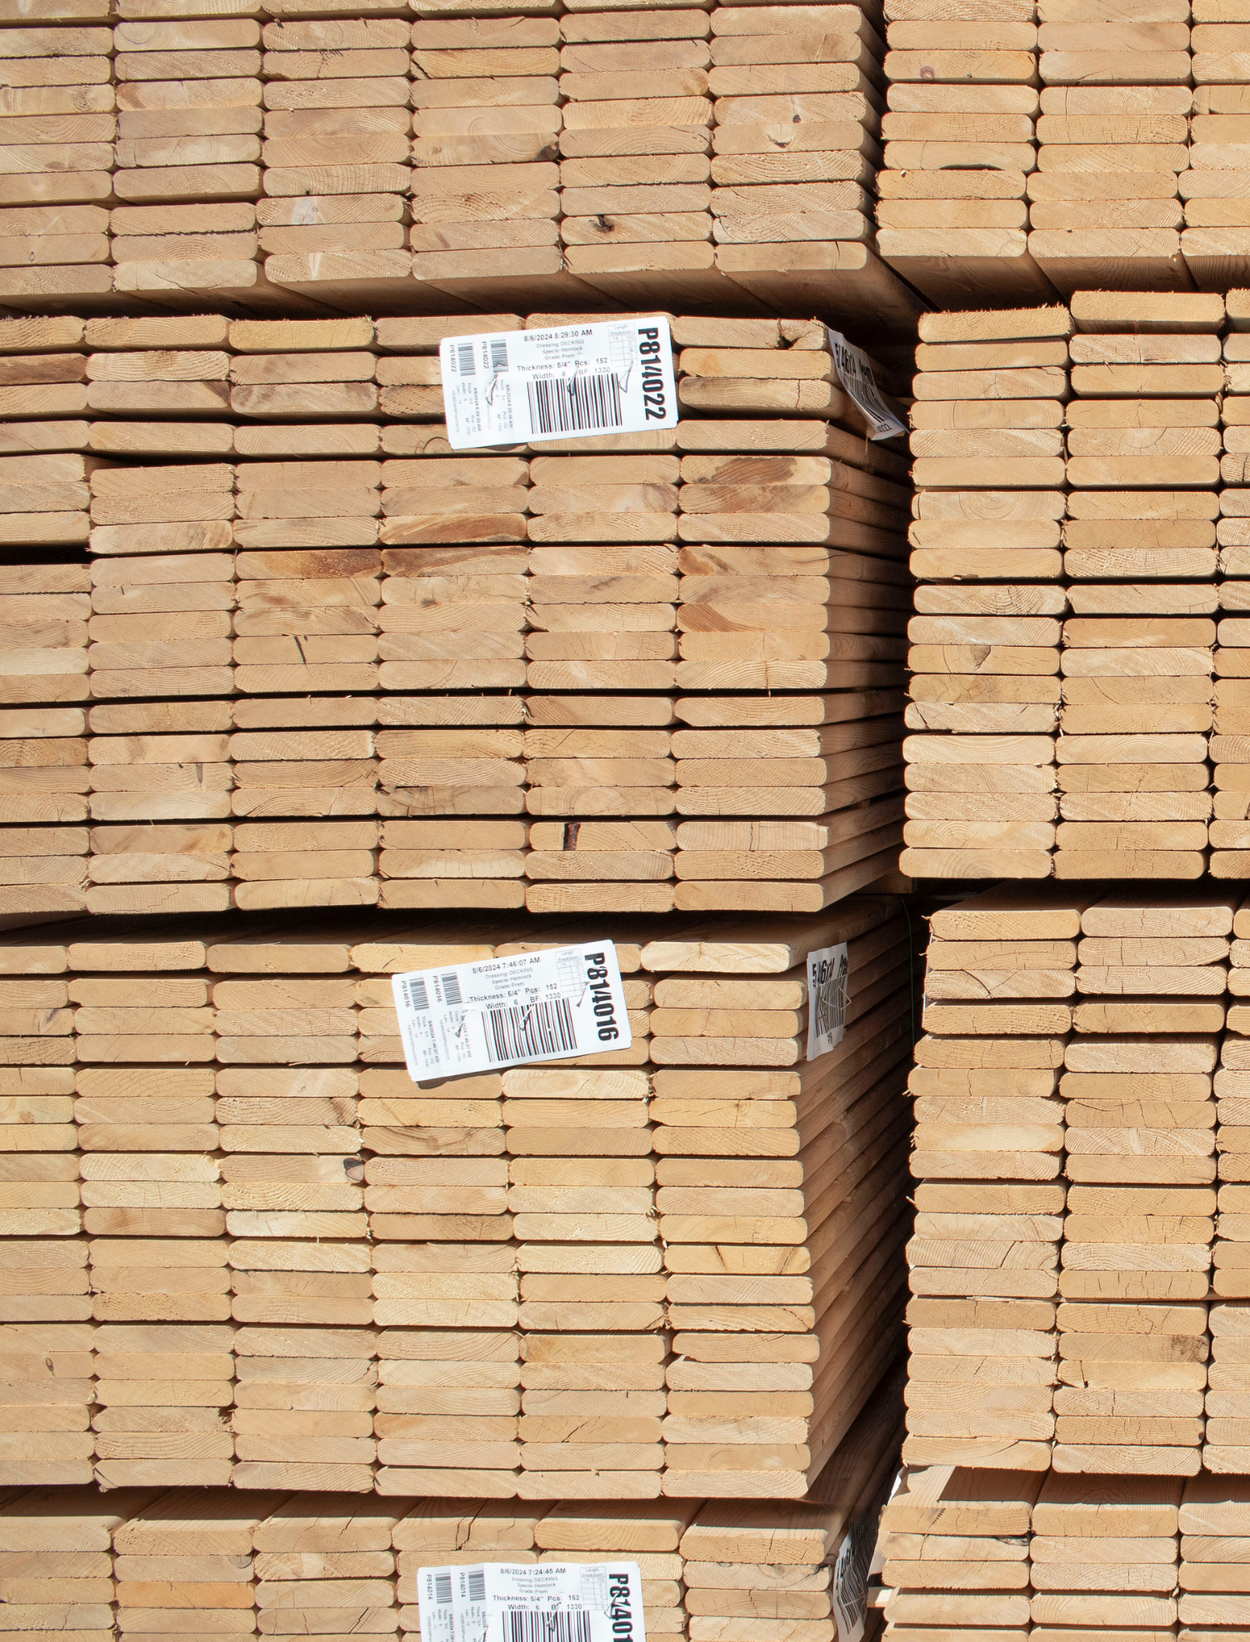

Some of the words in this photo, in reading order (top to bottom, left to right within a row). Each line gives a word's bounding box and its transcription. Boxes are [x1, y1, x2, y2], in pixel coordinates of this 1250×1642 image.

[524, 334, 553, 342] 8/6/2024
[449, 345, 457, 373] P814022
[481, 341, 489, 369] P814022
[517, 362, 554, 372] Thickness:
[532, 372, 555, 380] Width:
[639, 328, 666, 419] P814022
[472, 964, 501, 974] 8/6/2024
[401, 980, 411, 1008] P814016
[432, 975, 442, 1003] P814016
[469, 991, 506, 1003] Thickness:
[525, 986, 541, 994] Pcs:
[585, 953, 618, 1040] P814016
[486, 1001, 508, 1010] Width:
[530, 995, 542, 1003] BF:
[545, 992, 561, 1000] 1330
